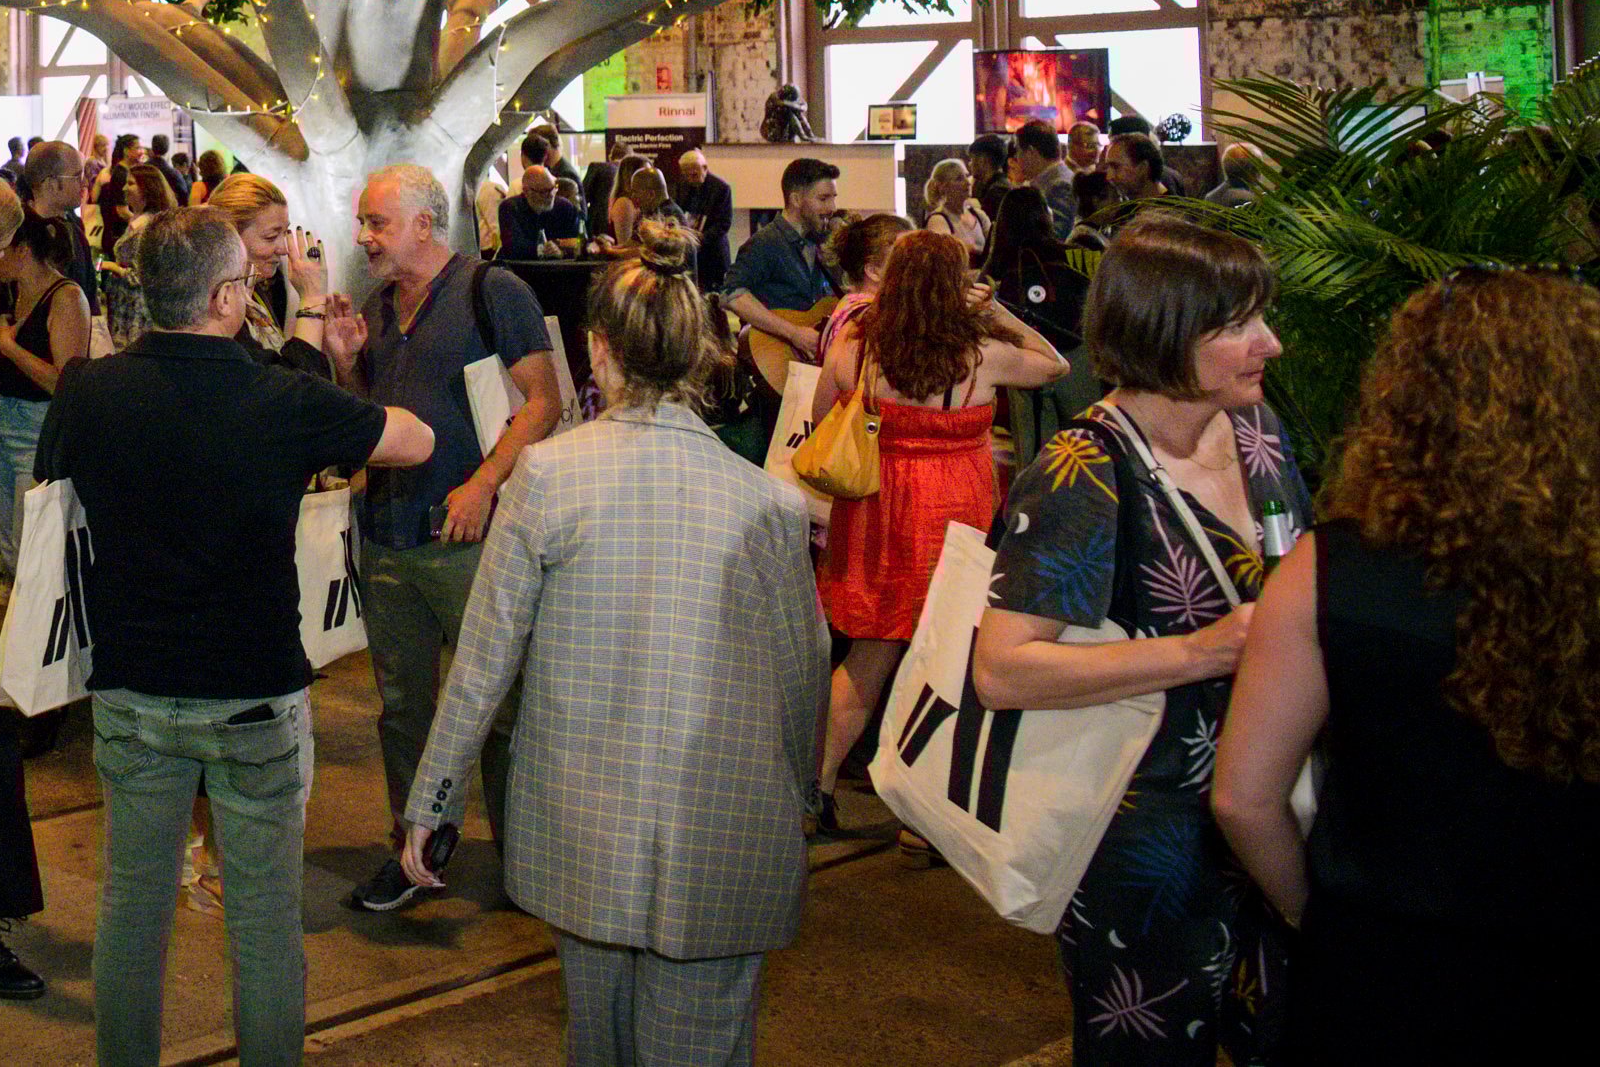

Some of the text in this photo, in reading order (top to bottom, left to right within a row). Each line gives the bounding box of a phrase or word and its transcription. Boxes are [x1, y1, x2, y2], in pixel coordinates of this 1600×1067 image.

[128, 101, 149, 110] WOOD
[150, 100, 171, 110] EFFECT
[103, 111, 160, 120] ALUMINIUM FINISH
[658, 106, 696, 117] Rinnai
[615, 134, 684, 142] Electric Perfection
